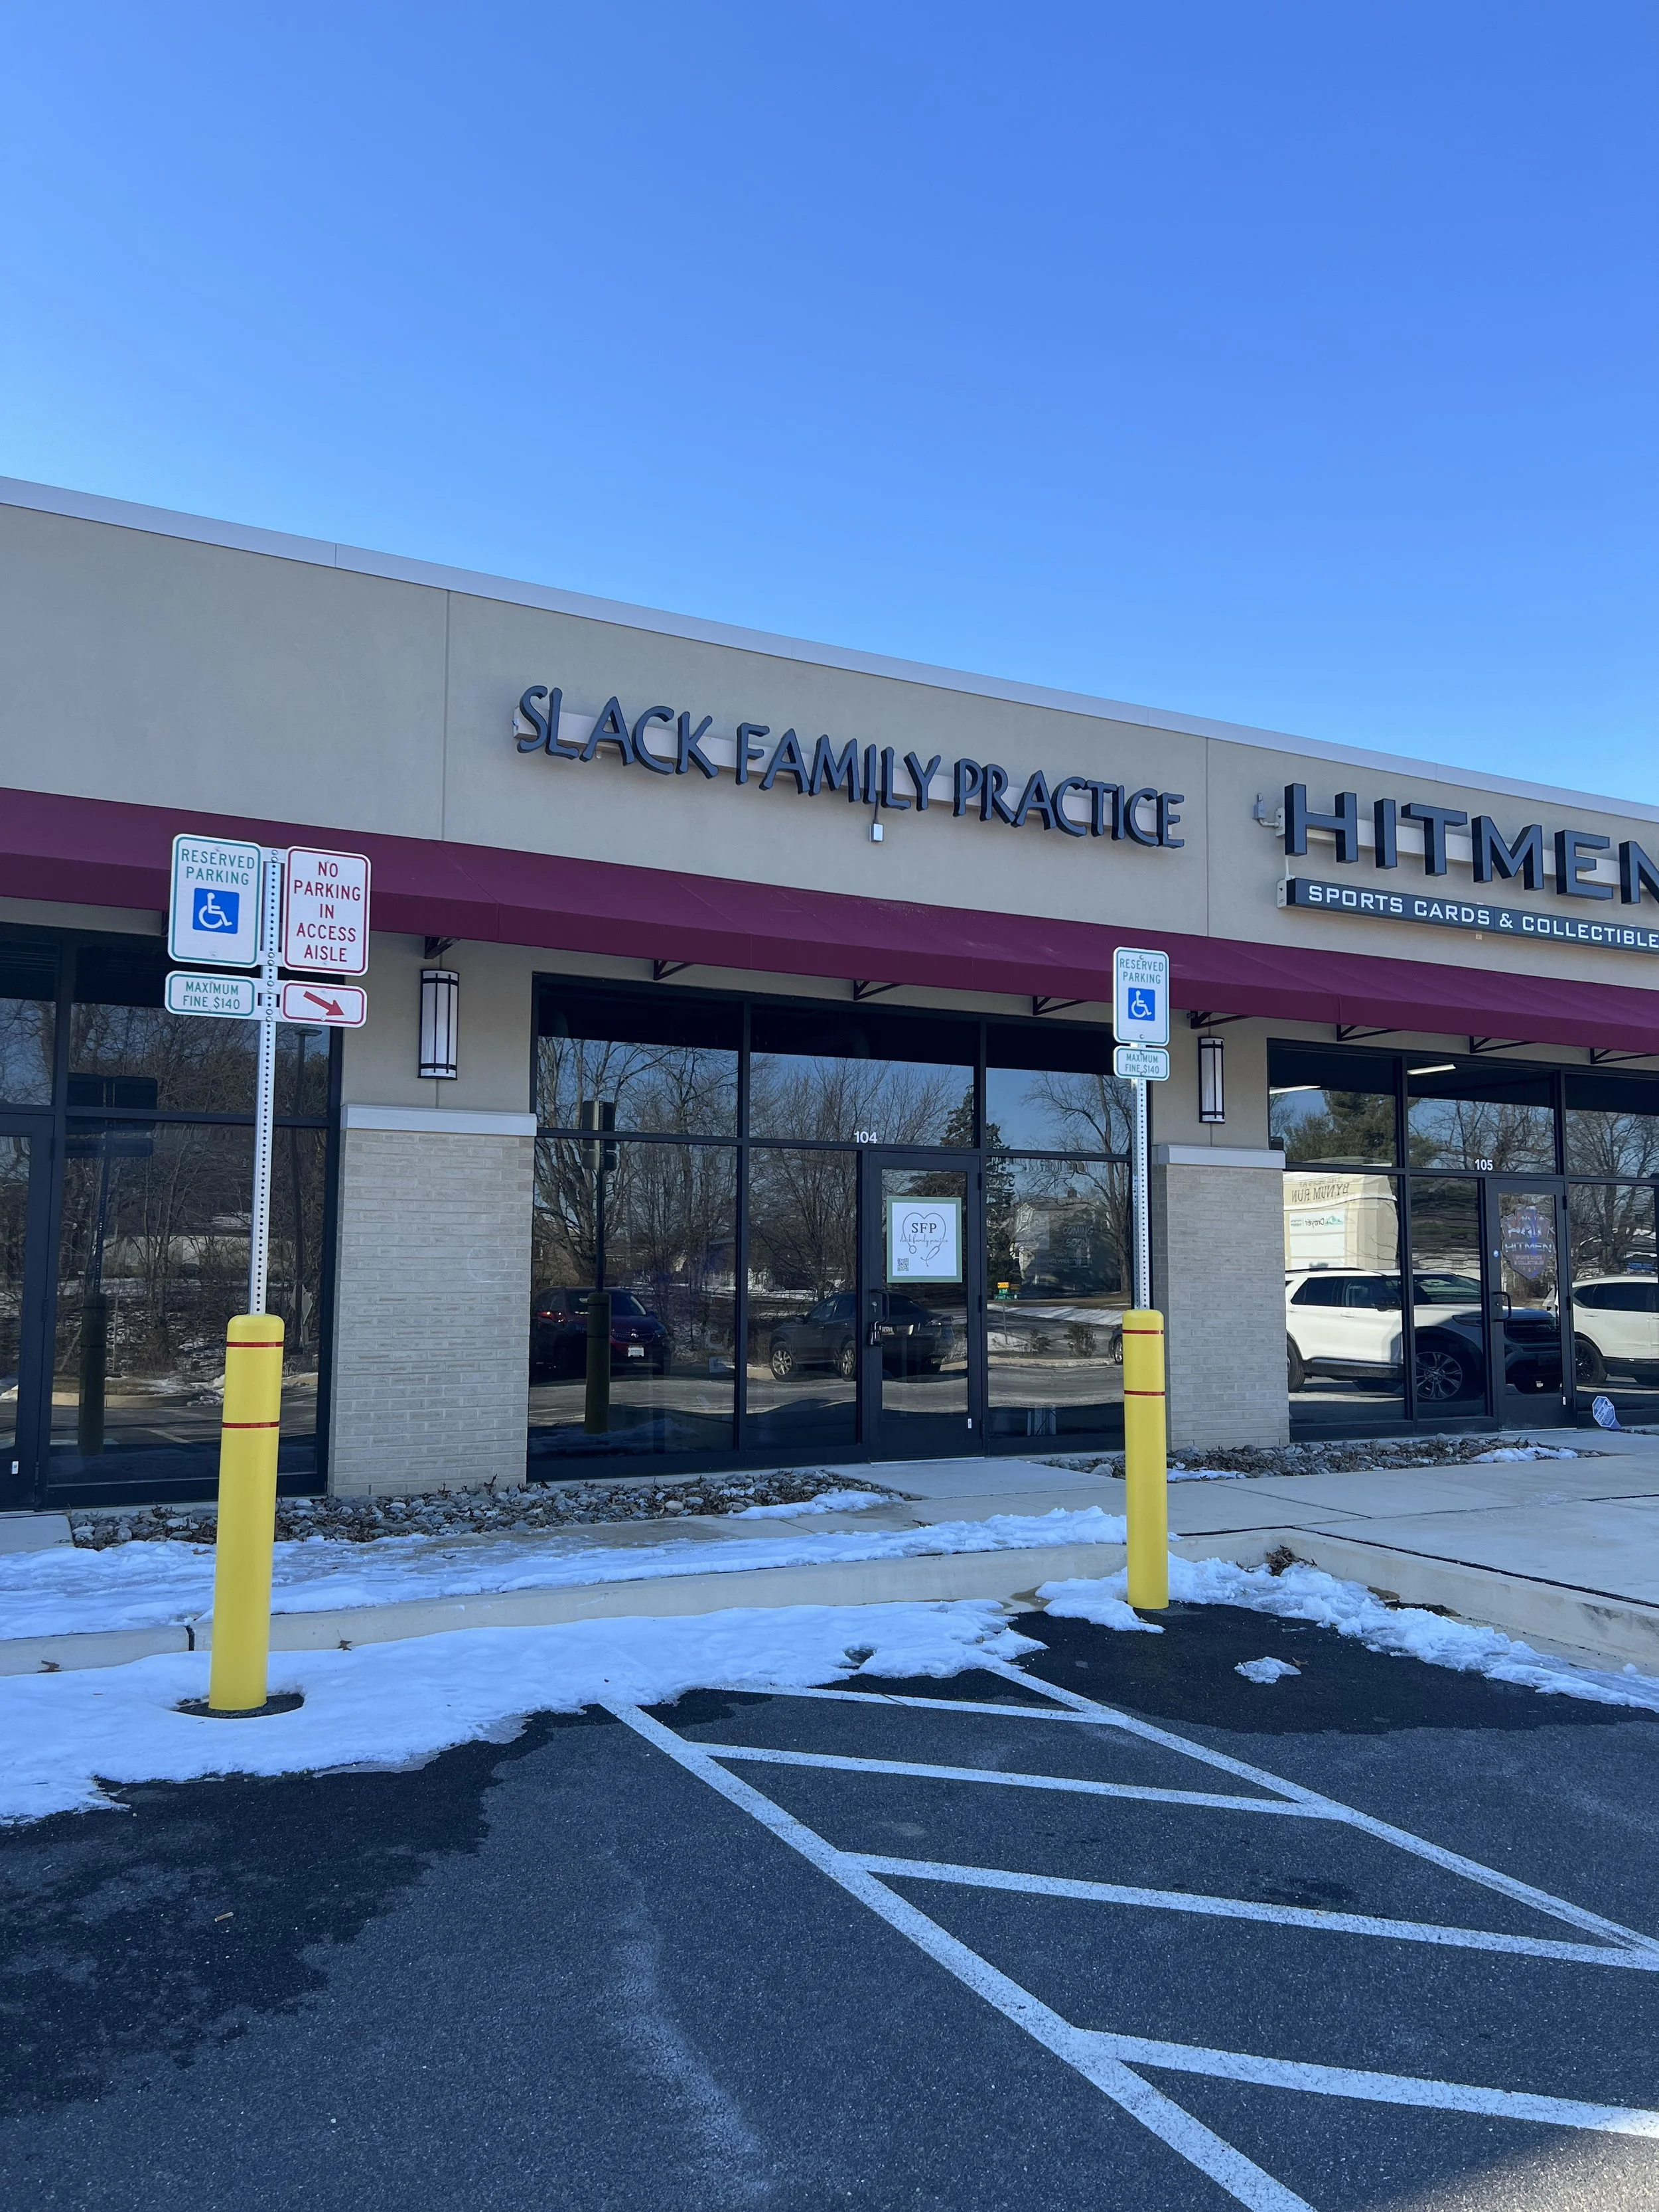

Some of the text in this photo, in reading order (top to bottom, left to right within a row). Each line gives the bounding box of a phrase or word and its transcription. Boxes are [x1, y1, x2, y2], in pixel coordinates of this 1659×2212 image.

[516, 685, 1185, 848] SLACK FAMILY PRACTICE
[181, 848, 255, 869] RESERVED
[318, 861, 338, 877] NO
[186, 867, 249, 886] PARKING
[293, 880, 361, 901] PARKING
[320, 903, 334, 920] IN
[1309, 885, 1659, 948] SPORTS CARDS & COLLECTIBLE
[296, 922, 356, 942] ACCESS
[304, 944, 348, 962] AISLE
[1119, 958, 1164, 972] RESERVED
[1123, 972, 1161, 984] PARKING
[186, 981, 239, 995] MAXIMUM
[182, 995, 240, 1009] FINE $140
[1126, 1053, 1158, 1063] MAXIMUM
[1125, 1064, 1159, 1074] FINE $140
[853, 1131, 878, 1143] 104
[1475, 1159, 1493, 1171] 105
[911, 1222, 937, 1234] SFP
[1063, 1225, 1094, 1235] COMING
[1504, 1242, 1552, 1253] HITMEN
